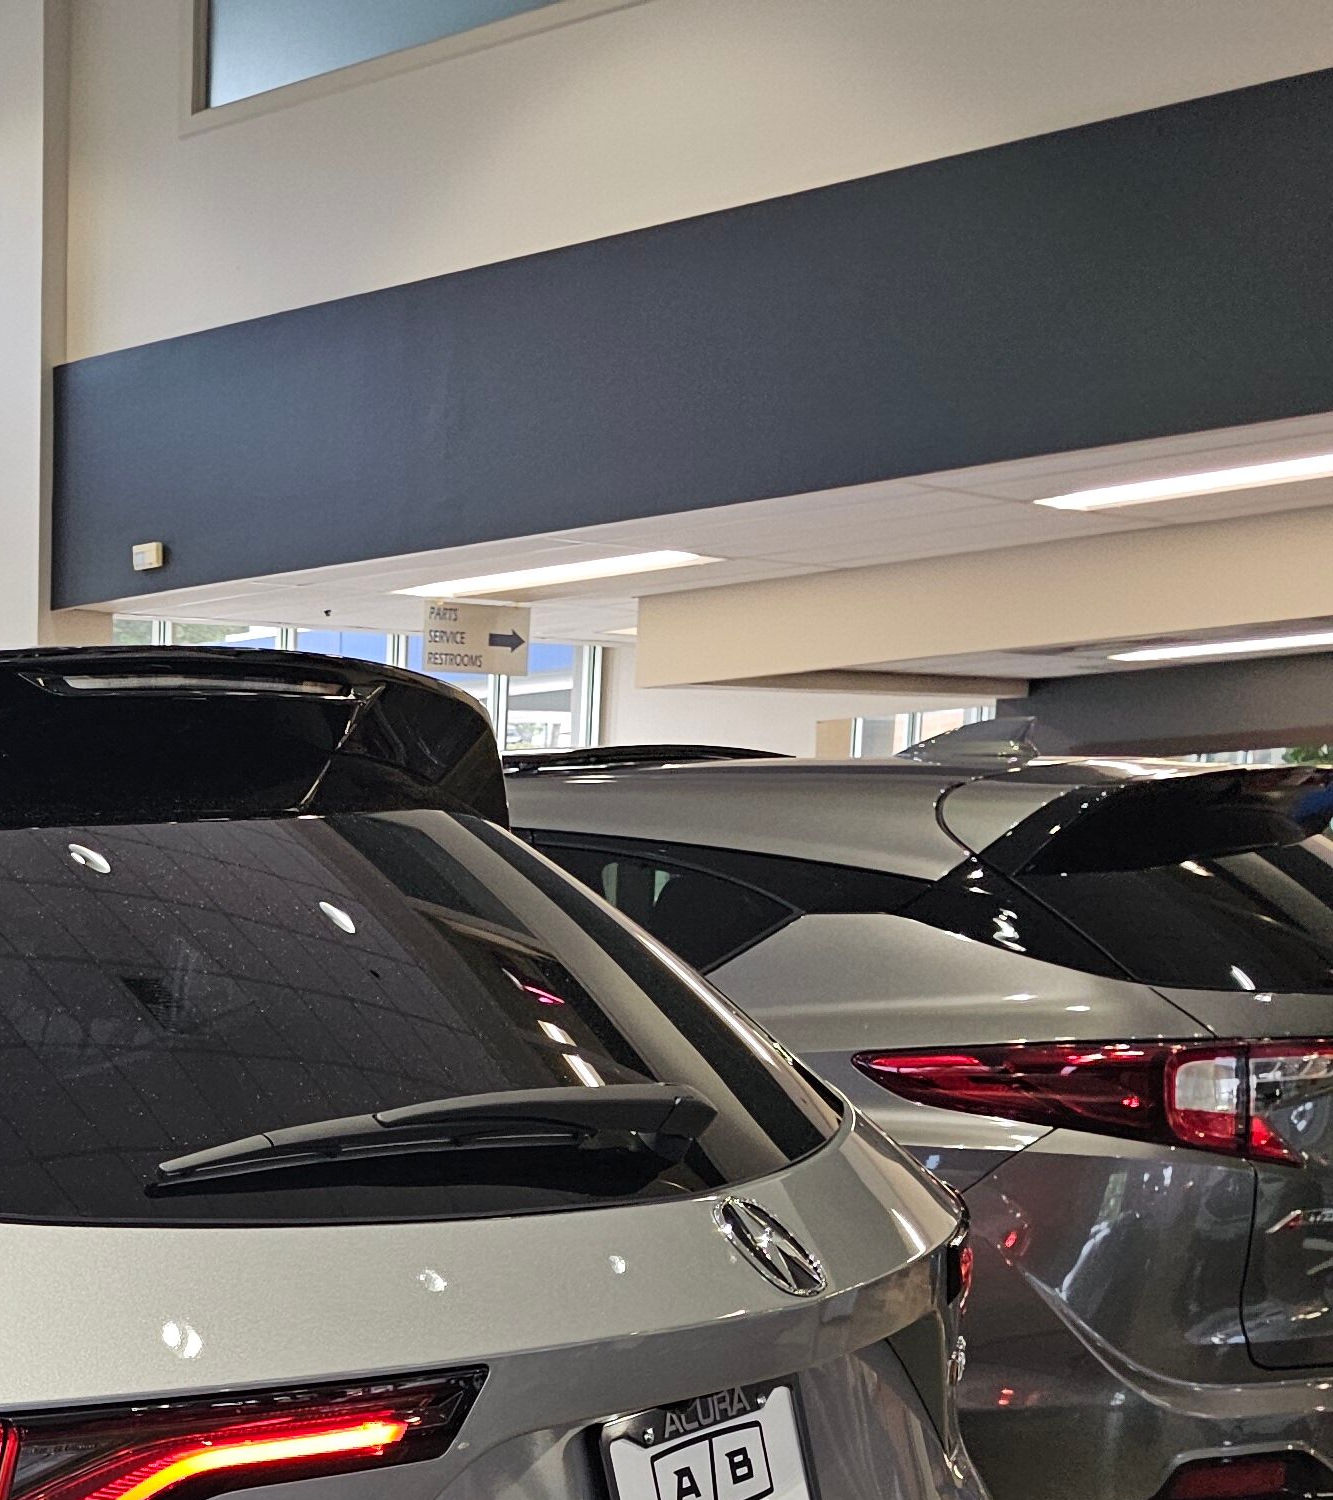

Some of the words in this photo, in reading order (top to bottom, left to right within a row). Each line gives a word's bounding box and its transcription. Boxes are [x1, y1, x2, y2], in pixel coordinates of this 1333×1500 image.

[428, 606, 459, 622] PARTS
[428, 629, 466, 645] SERVICE
[426, 651, 483, 668] RESTROOMS
[663, 1387, 751, 1439] ACURA
[724, 1445, 755, 1486] B
